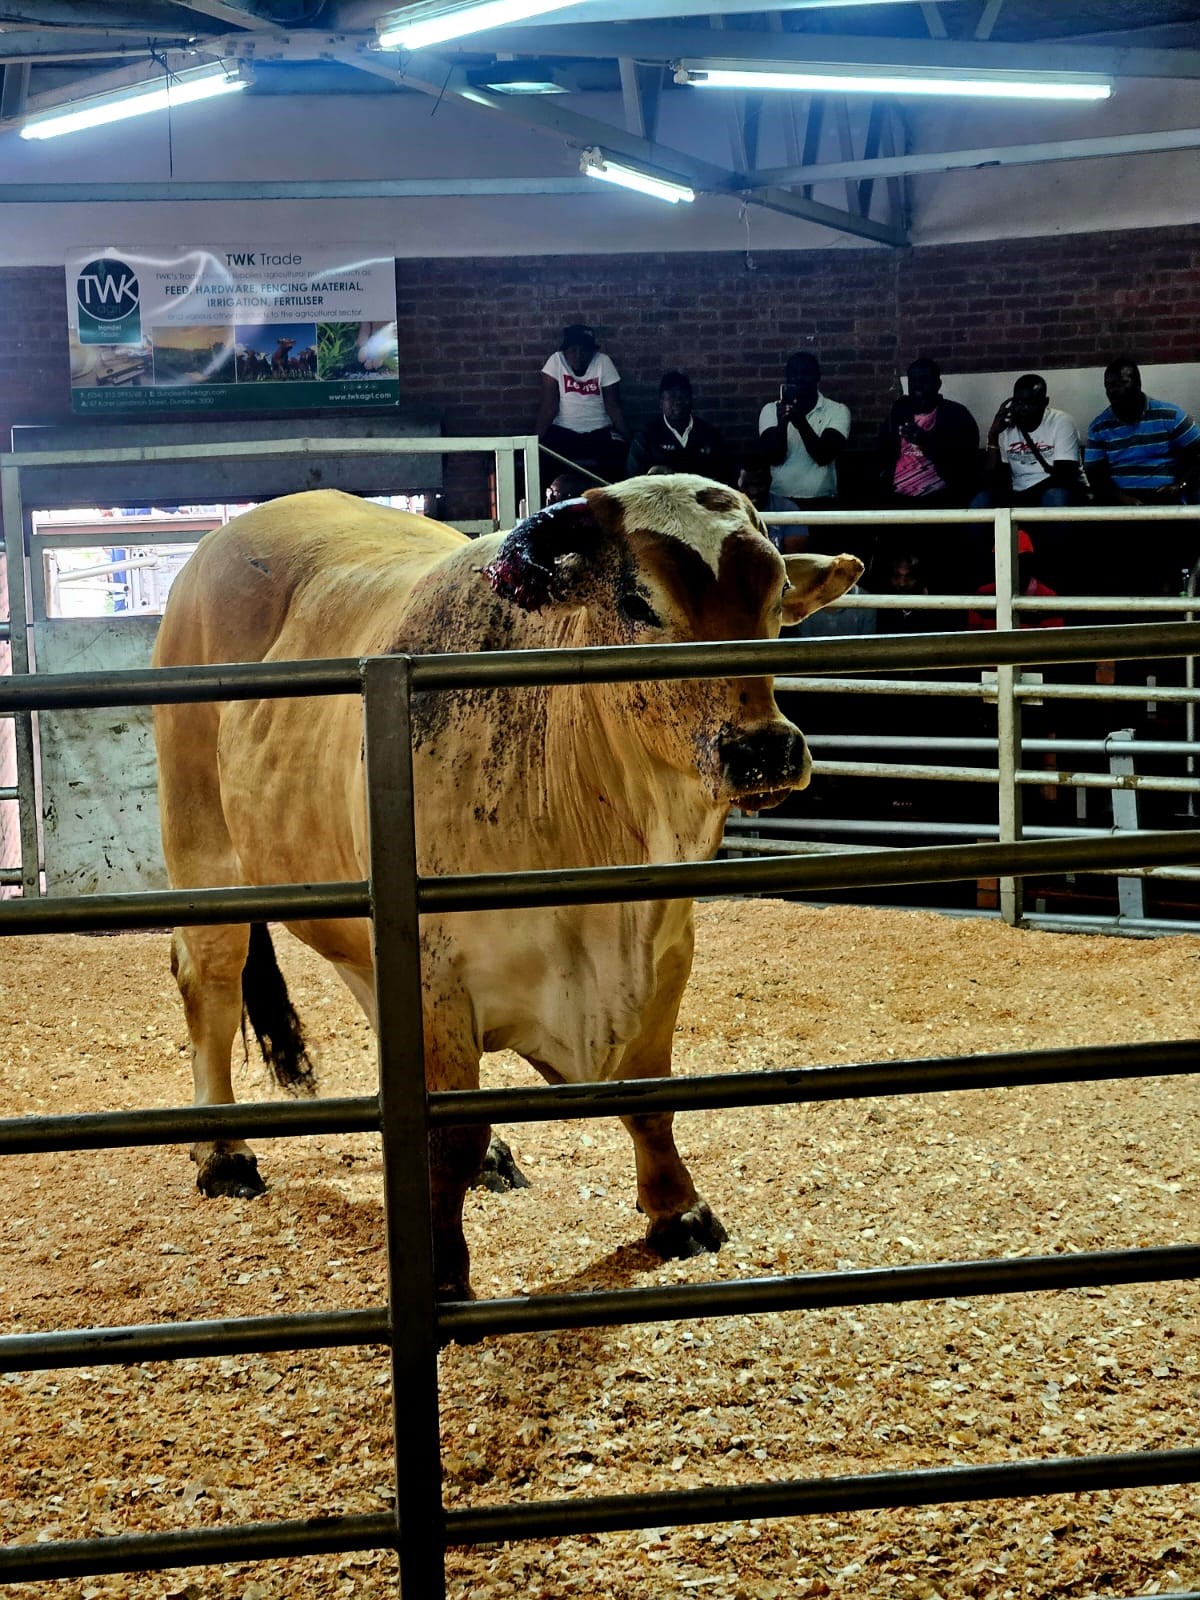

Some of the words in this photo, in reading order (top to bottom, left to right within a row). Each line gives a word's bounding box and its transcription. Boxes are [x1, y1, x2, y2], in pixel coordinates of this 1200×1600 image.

[226, 253, 256, 266] TWK
[260, 251, 302, 266] Trade
[263, 269, 305, 280] agricultural
[78, 273, 139, 304] TWK
[165, 285, 193, 296] FEED,
[196, 284, 259, 295] HARDWARE,
[261, 282, 308, 293] FENCING
[207, 297, 271, 308] IRRIGATION,
[274, 295, 324, 306] FERTILISER
[271, 309, 279, 318] to
[280, 308, 294, 318] the
[295, 307, 338, 319] agricultural
[328, 392, 392, 401] www.twkagri.com
